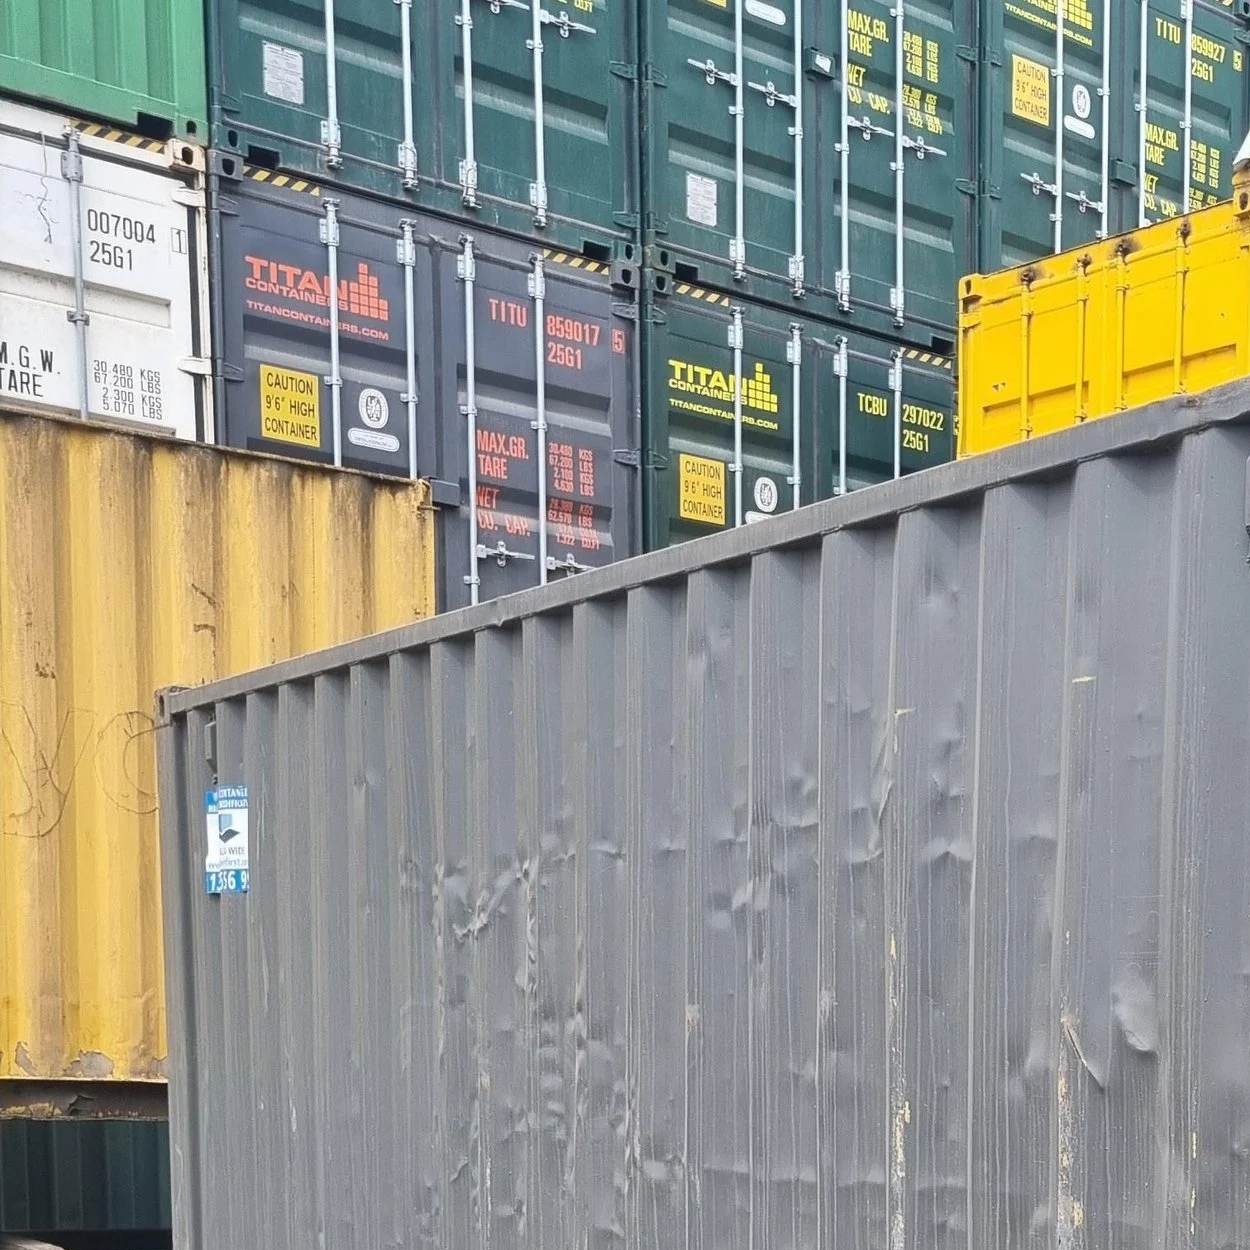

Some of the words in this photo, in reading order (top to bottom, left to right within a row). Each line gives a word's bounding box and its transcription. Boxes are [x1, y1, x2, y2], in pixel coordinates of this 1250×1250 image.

[848, 9, 889, 43] MAX.GR.
[848, 30, 872, 57] TARE
[1155, 17, 1181, 44] TITU
[1192, 33, 1226, 63] 859927
[848, 62, 866, 87] NET
[1017, 61, 1046, 83] CAUTION
[1192, 58, 1213, 83] 25G1
[1031, 85, 1047, 101] HIGH
[1015, 97, 1048, 120] CONTAINER
[1145, 142, 1164, 166] TARE
[87, 209, 156, 243] 007004
[90, 240, 133, 271] 25G1
[245, 255, 348, 301] TITAN
[489, 298, 527, 328] TITU
[546, 315, 600, 347] 859017
[613, 330, 624, 353] 5
[547, 342, 582, 370] 25G1
[94, 359, 133, 377] 30.480
[140, 368, 160, 383] KGS
[94, 371, 134, 389] 67.200
[140, 380, 161, 395] LBS
[668, 359, 748, 396] TITAN
[266, 372, 313, 396] CAUTION
[102, 387, 134, 403] 2.300
[141, 394, 162, 409] KGS
[103, 398, 135, 415] 5.070
[142, 406, 163, 420] LBS
[289, 399, 315, 418] HIGH
[669, 398, 778, 430] TITANCONTAINRS.COM
[857, 392, 887, 417] TCBU
[902, 404, 944, 431] 297022
[264, 417, 318, 441] CONTAINER
[902, 429, 929, 452] 25G1
[477, 429, 529, 460] MAX.GR.
[478, 454, 508, 480] TARE
[684, 461, 721, 480] CAUTION
[476, 485, 500, 509] NET
[702, 483, 722, 500] HIGH
[683, 499, 723, 519] CONTAINER
